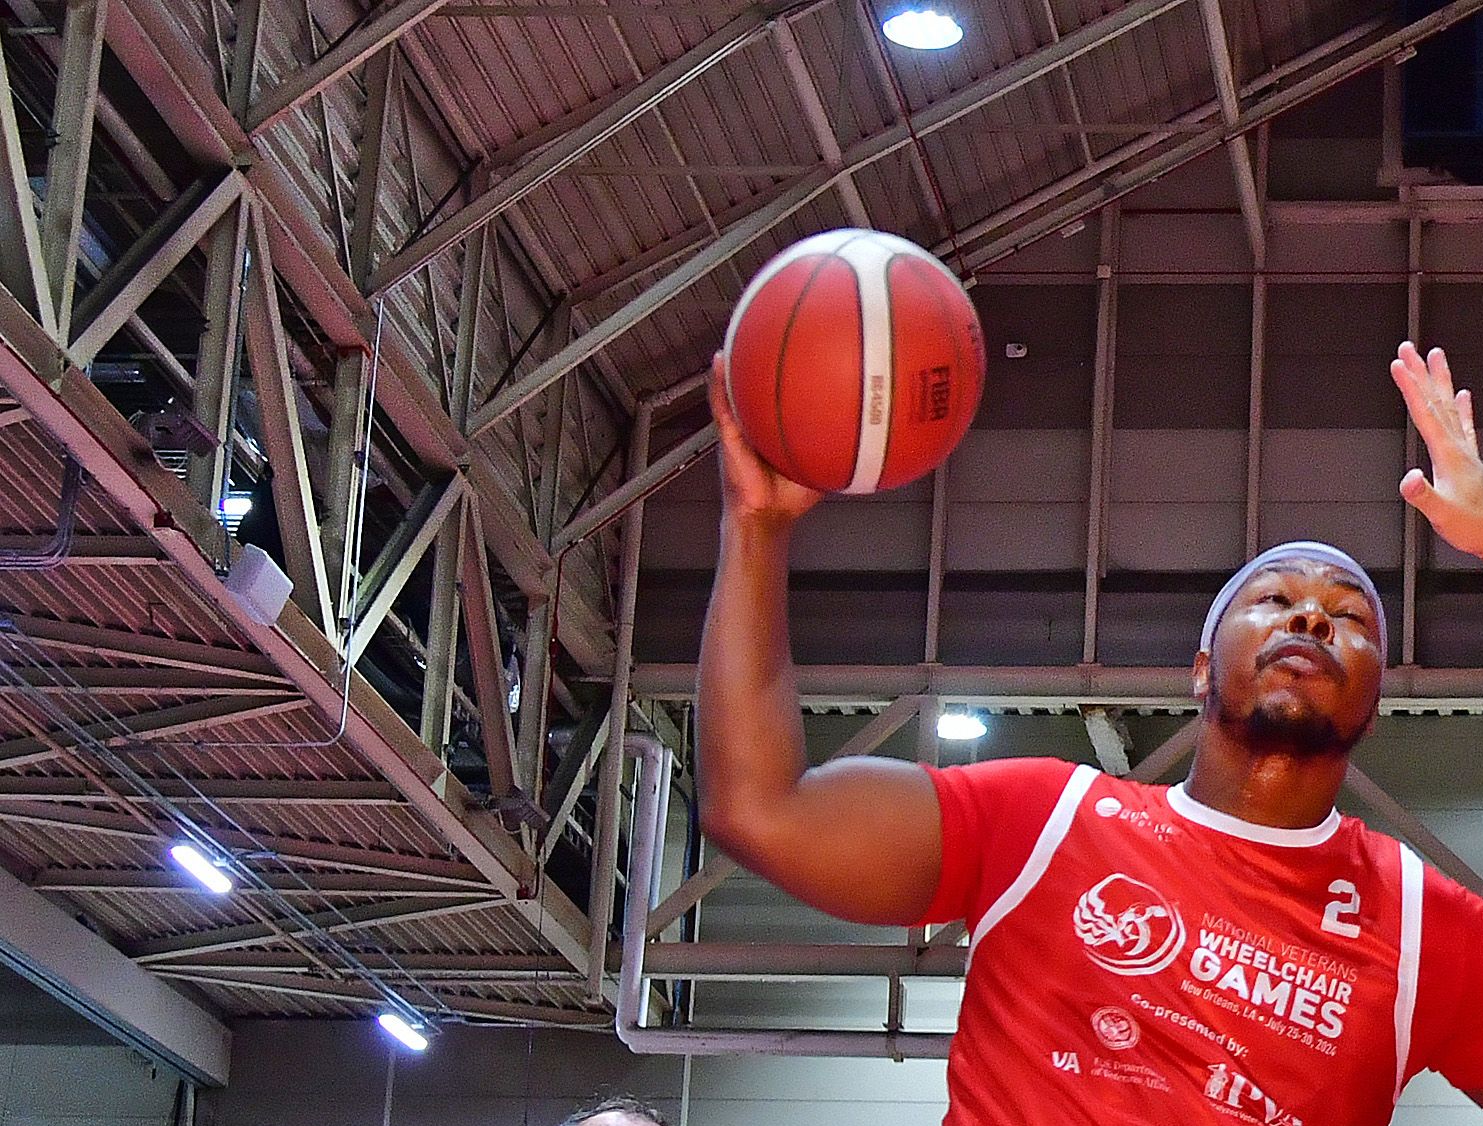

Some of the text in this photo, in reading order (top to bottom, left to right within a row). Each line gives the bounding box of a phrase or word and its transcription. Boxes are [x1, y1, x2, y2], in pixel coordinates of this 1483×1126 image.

[1320, 879, 1361, 939] 2
[1200, 929, 1353, 1005] WHEELCHAIR
[1201, 912, 1359, 982] NATIONAL VETERANS
[1180, 979, 1338, 1057] New Orleans, LA July 25-30, 2024
[1190, 947, 1347, 1039] GAMES
[1052, 1051, 1081, 1074] VA
[1226, 1037, 1249, 1058] by:
